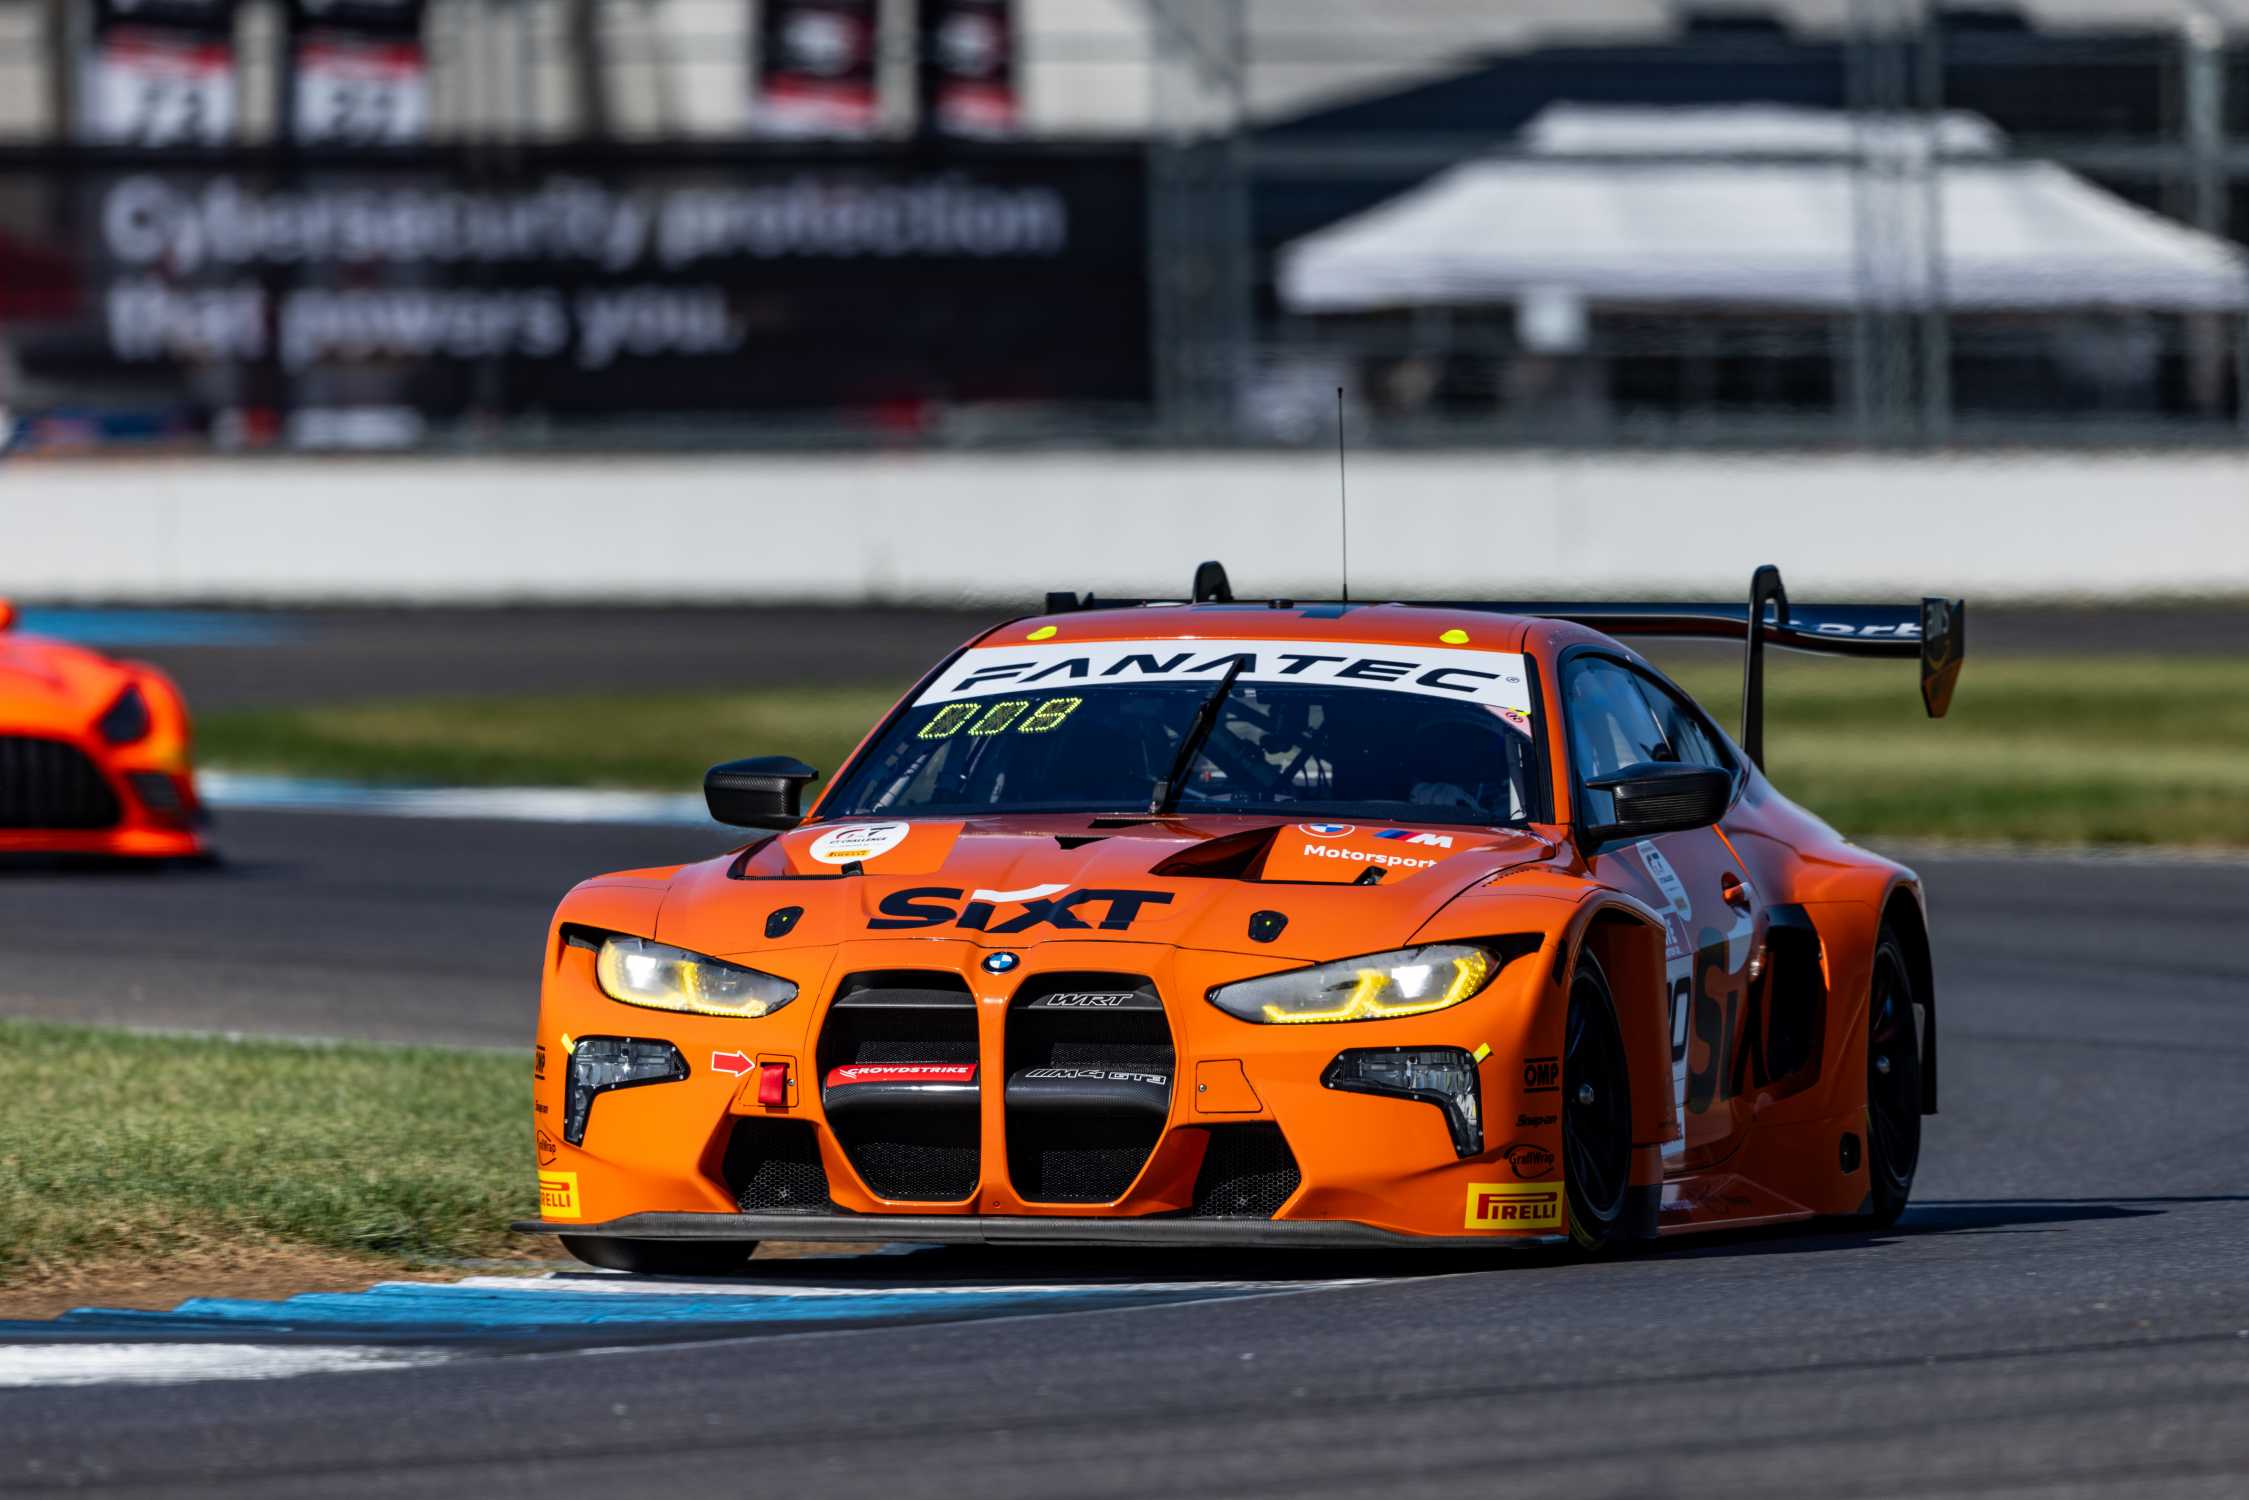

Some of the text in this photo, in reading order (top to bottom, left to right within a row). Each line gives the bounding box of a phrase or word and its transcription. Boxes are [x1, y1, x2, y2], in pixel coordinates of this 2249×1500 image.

[658, 174, 1068, 268] protection
[105, 283, 266, 362] that
[278, 287, 571, 374] powers
[951, 652, 1500, 693] FANATEC
[1304, 844, 1437, 868] Motorsport
[1047, 993, 1134, 1006] WRT
[846, 1065, 969, 1075] CROWDSTRIKE
[1108, 1071, 1167, 1086] GT3
[1524, 1063, 1559, 1087] OMP
[1476, 1192, 1558, 1220] PIRELLI
